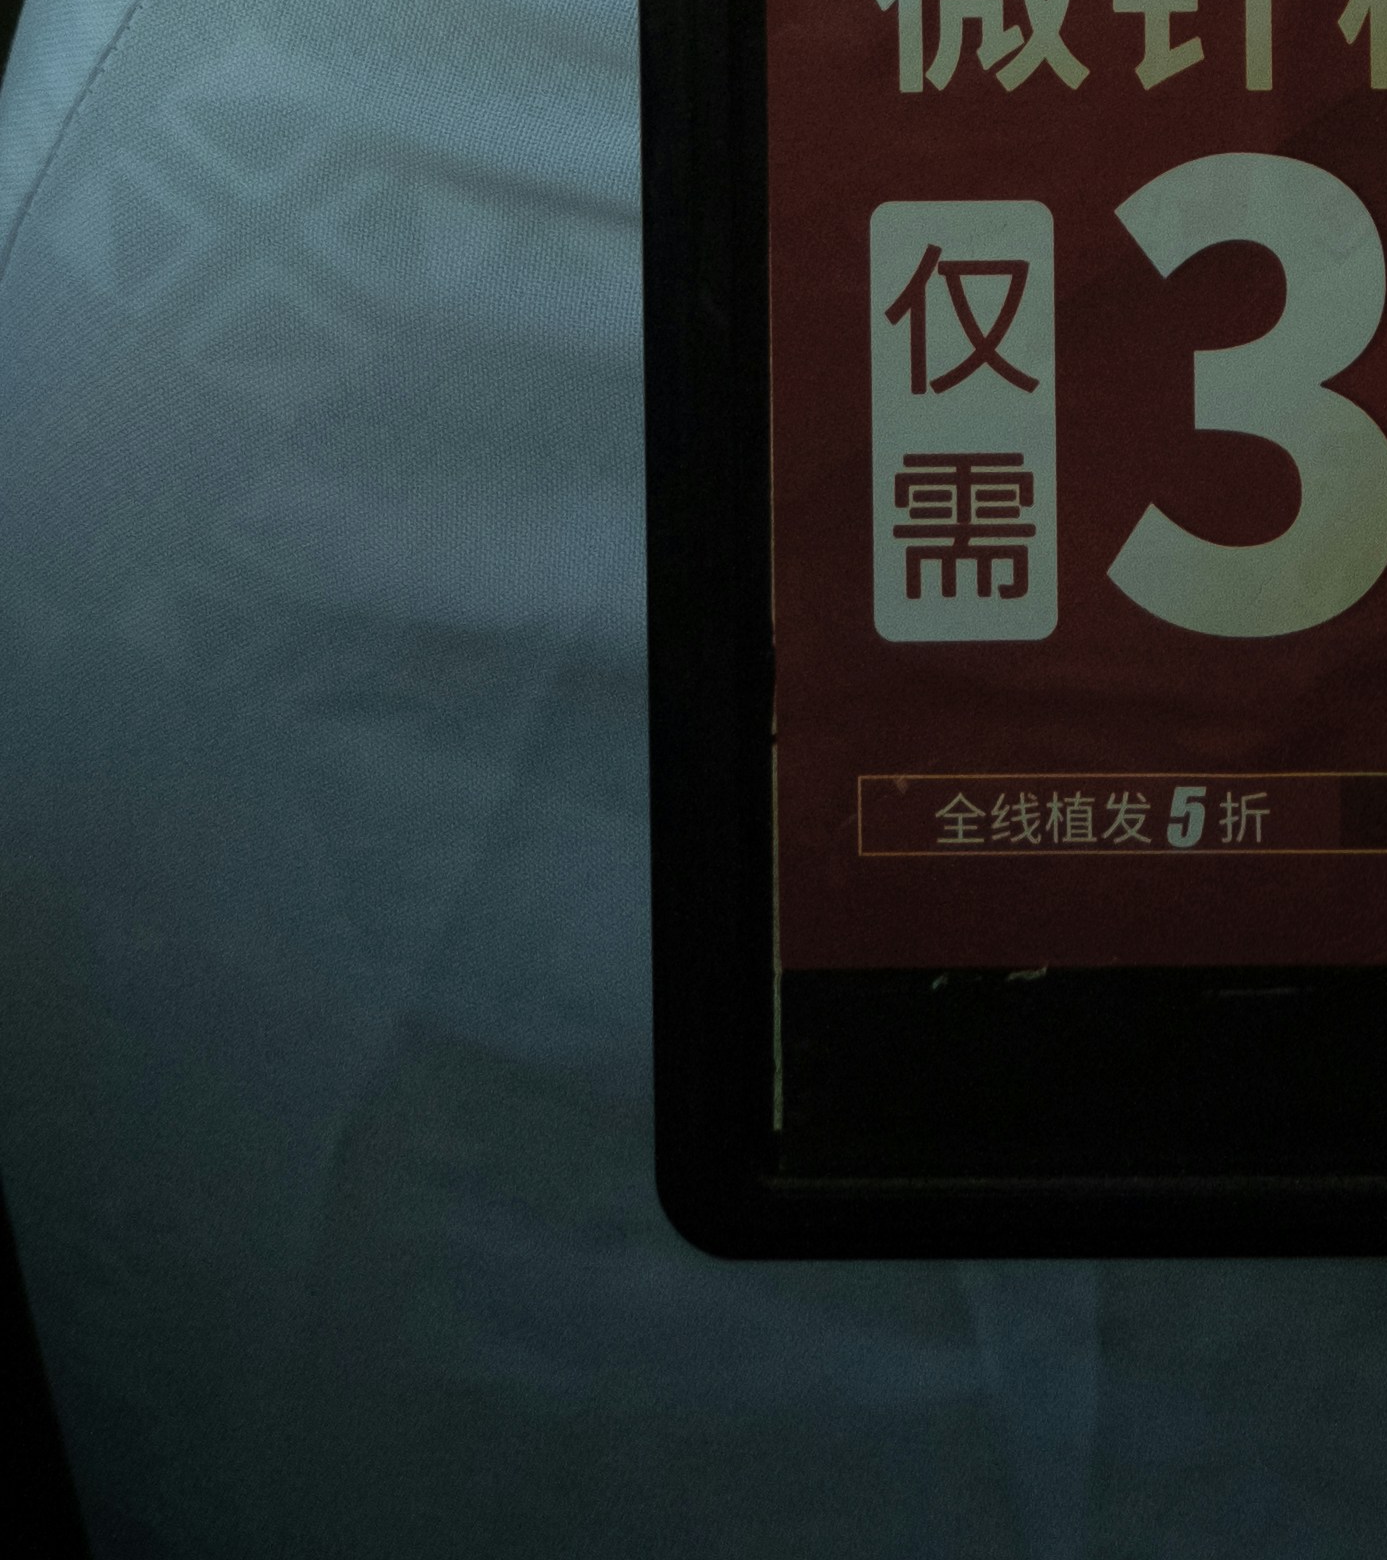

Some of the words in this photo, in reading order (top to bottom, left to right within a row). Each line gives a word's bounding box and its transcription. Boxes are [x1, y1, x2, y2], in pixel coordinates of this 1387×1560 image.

[884, 243, 1040, 600] 仅需
[934, 785, 1271, 849] 全线植发5折
